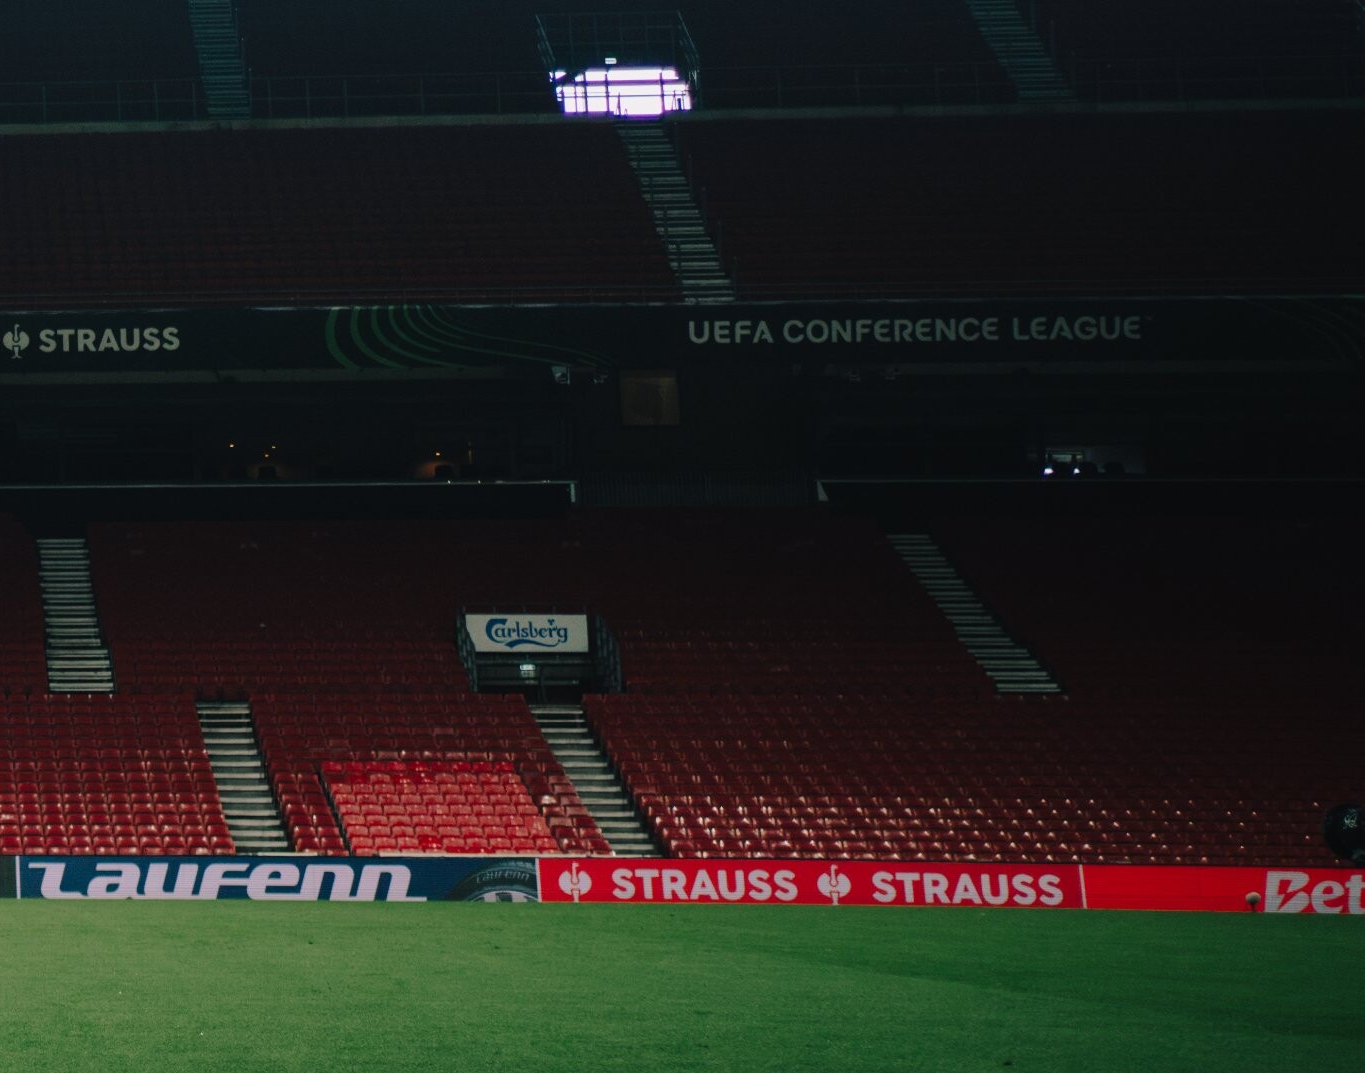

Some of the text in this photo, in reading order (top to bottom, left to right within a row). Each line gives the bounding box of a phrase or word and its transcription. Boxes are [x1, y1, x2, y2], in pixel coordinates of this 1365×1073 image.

[38, 326, 181, 353] STRAUSS
[688, 315, 1142, 345] UEFA CONFERENCE LEAGUE
[485, 618, 568, 648] Carlsberg
[612, 868, 1064, 905] STRAUSS STRAUSS
